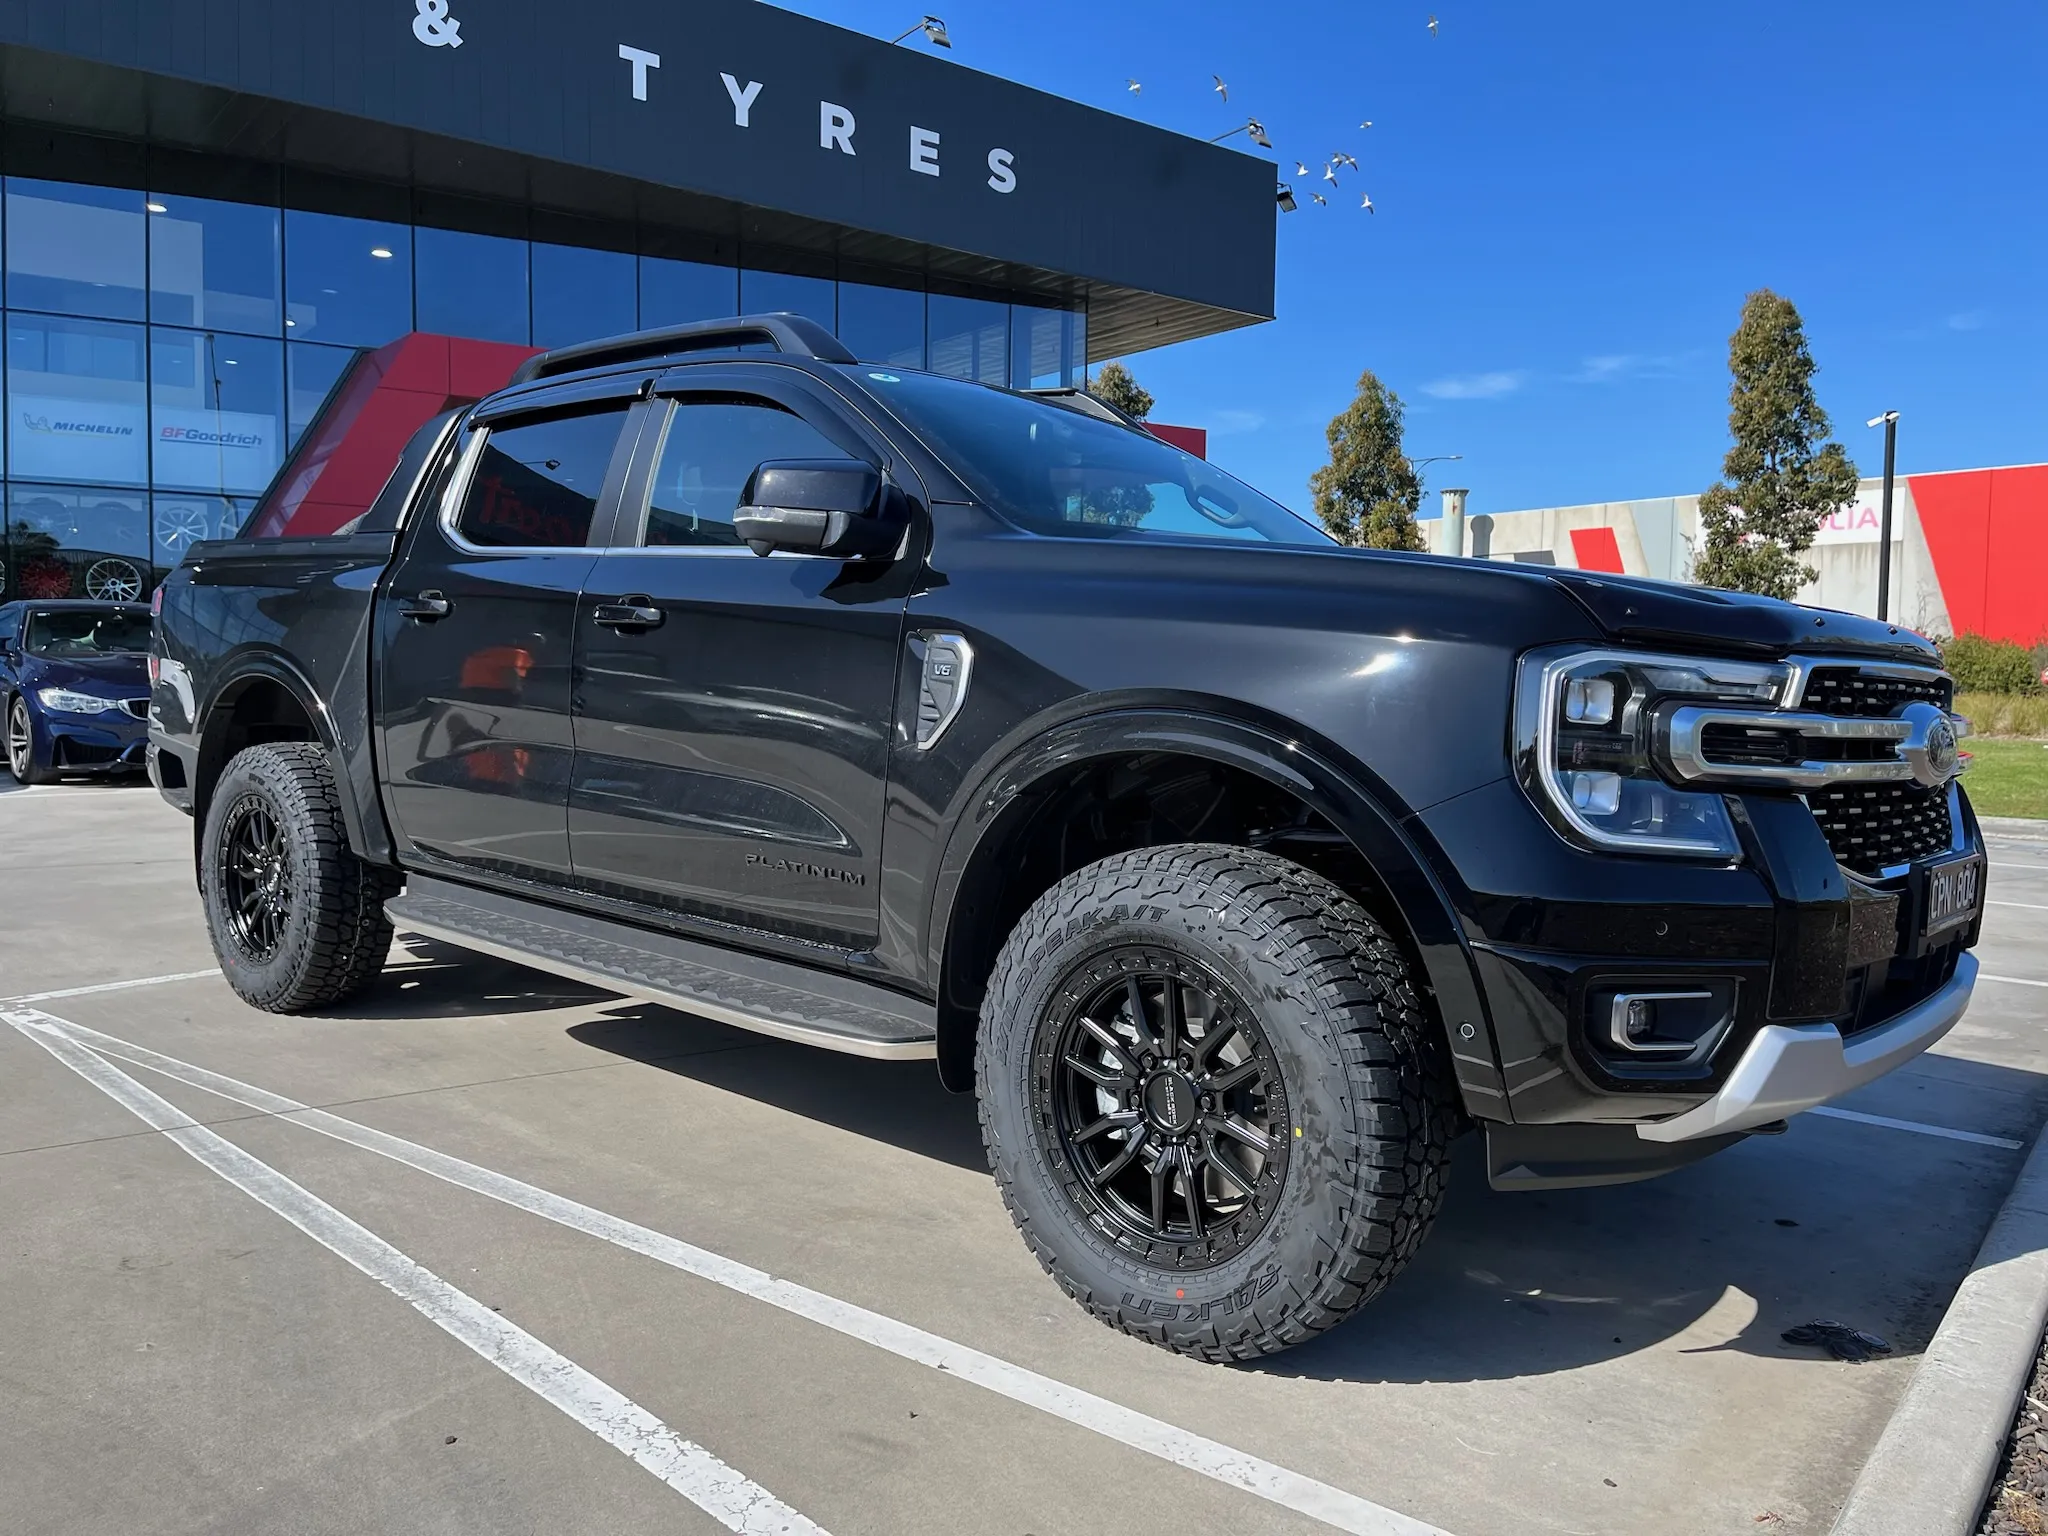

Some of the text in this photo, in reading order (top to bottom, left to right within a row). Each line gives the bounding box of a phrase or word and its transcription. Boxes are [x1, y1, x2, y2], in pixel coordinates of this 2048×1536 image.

[412, 0, 1017, 194] & TYRES
[53, 421, 133, 436] MICHELIN
[160, 426, 263, 446] BFGoodrich
[934, 664, 951, 676] V6
[745, 853, 866, 886] PLATINUM
[1110, 904, 1170, 922] A/T
[1121, 1263, 1283, 1323] FALKEN
